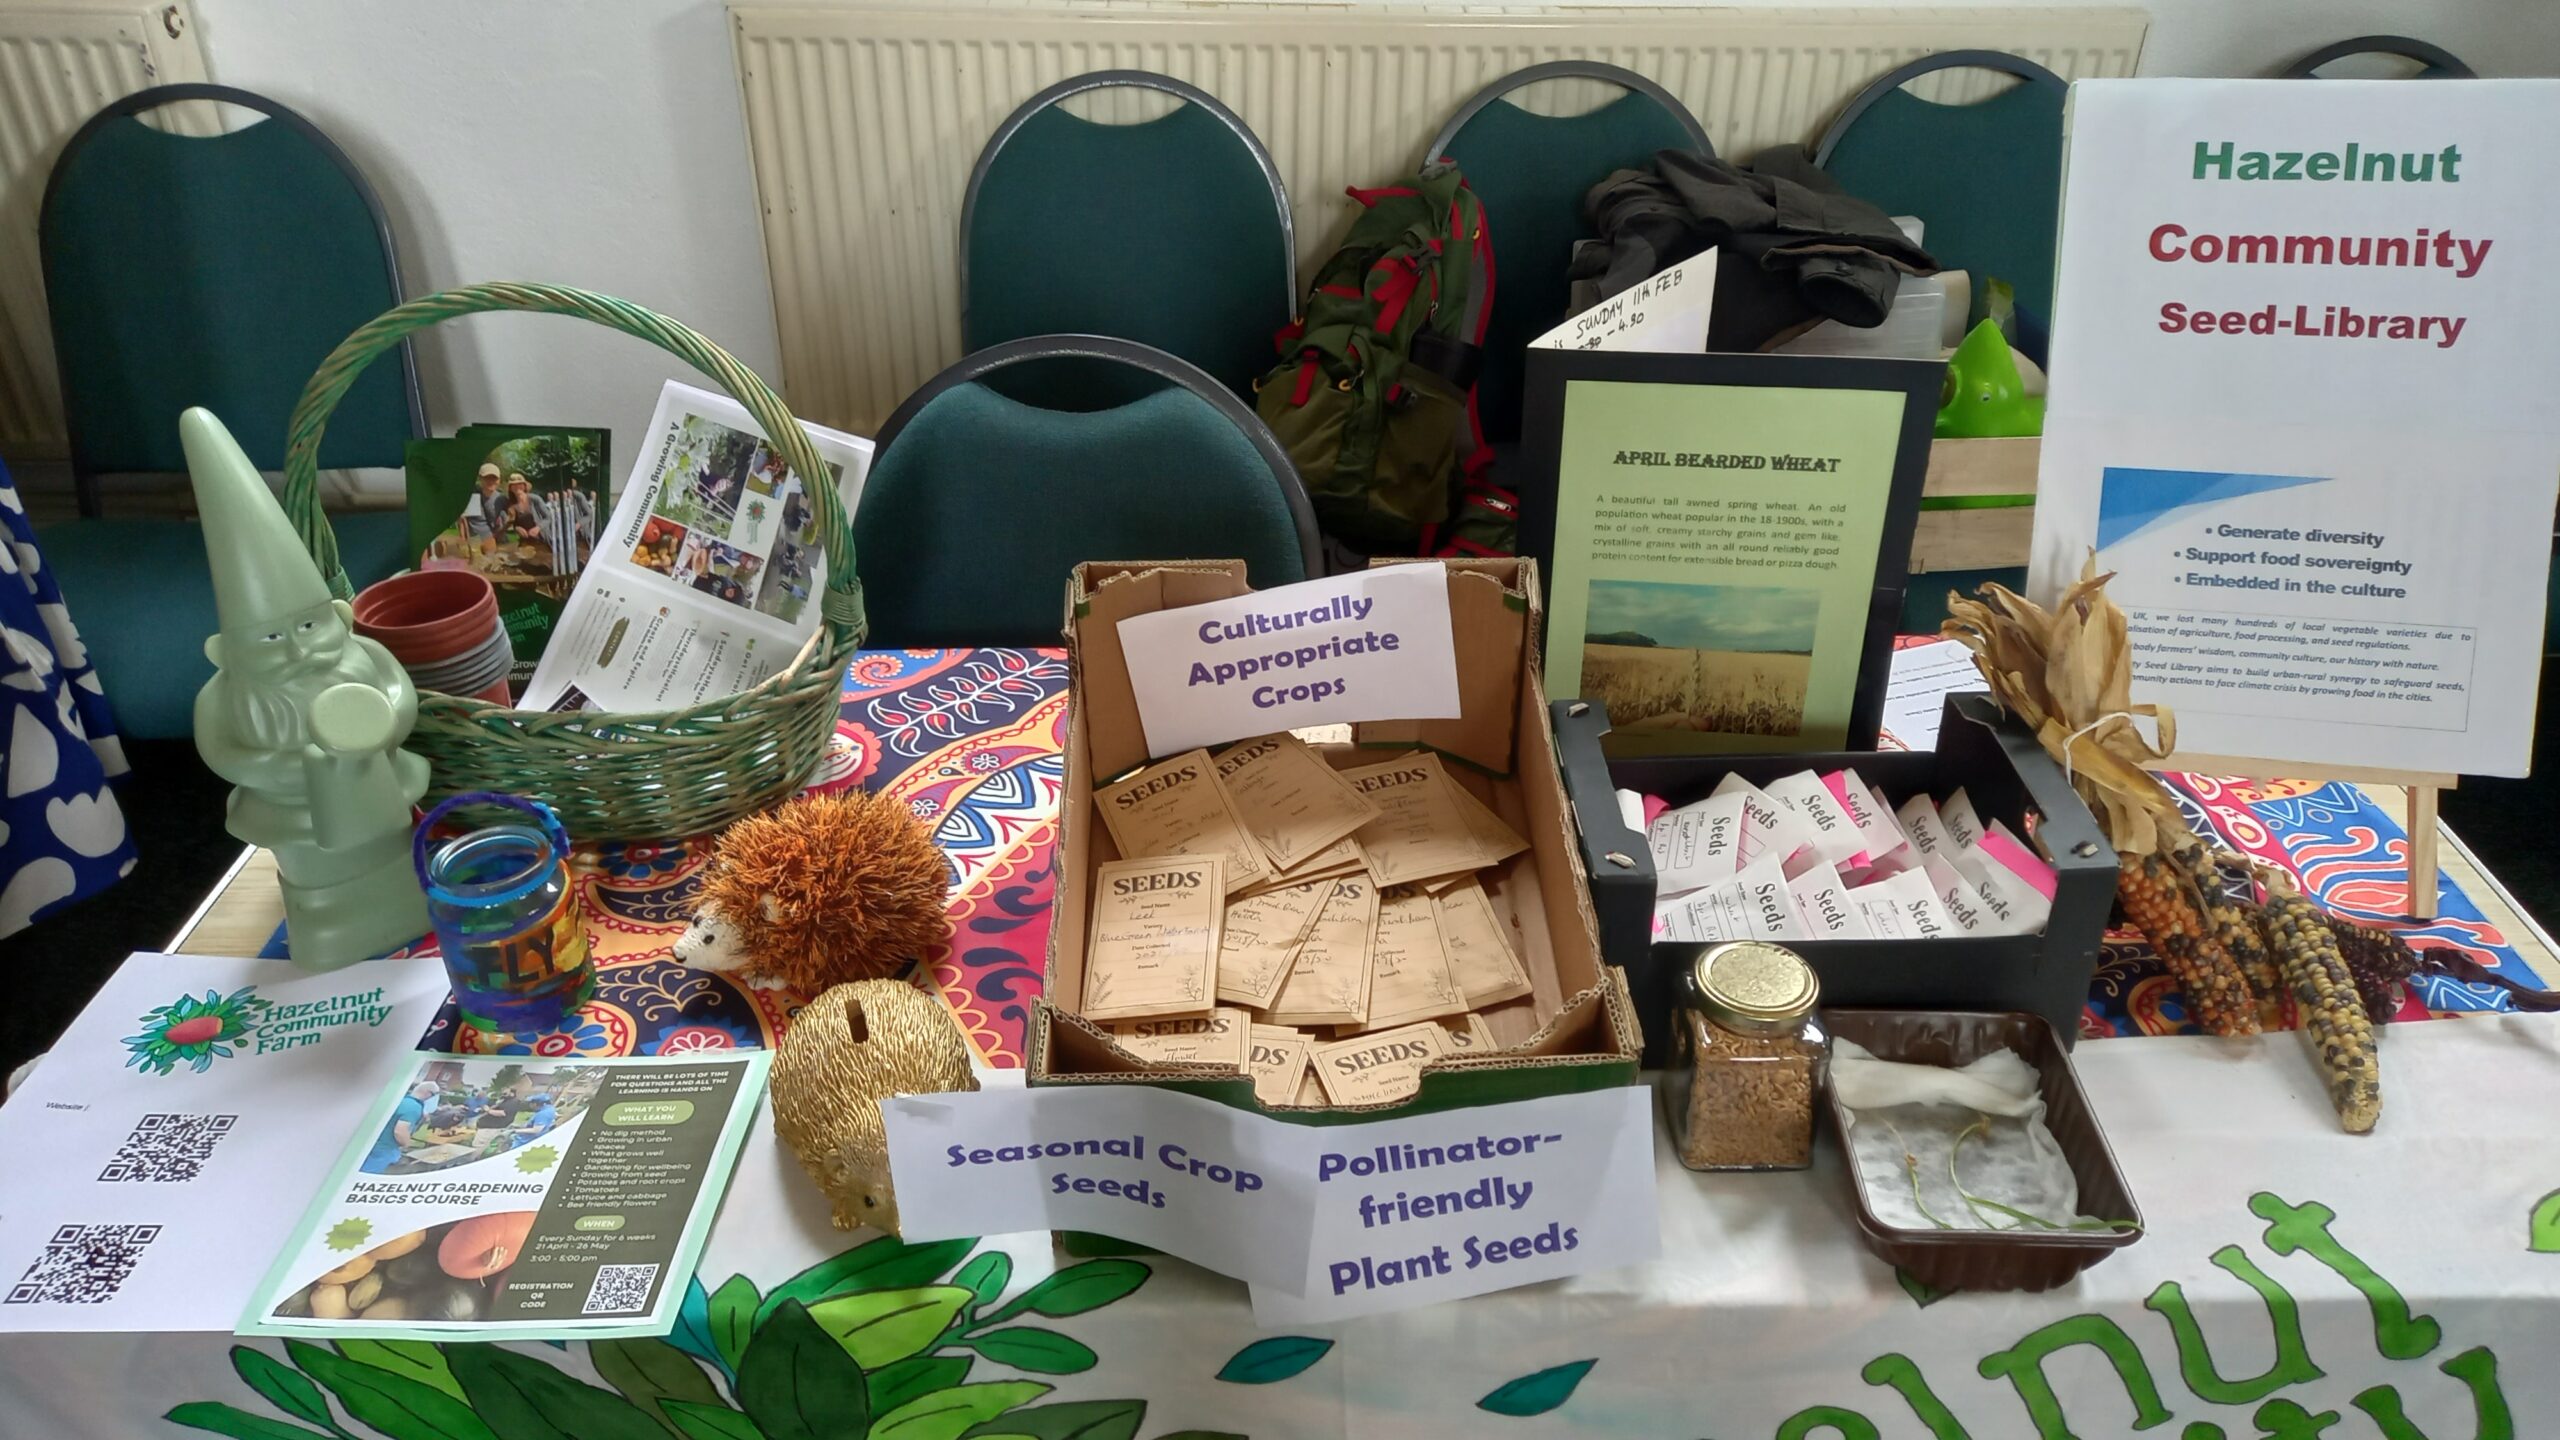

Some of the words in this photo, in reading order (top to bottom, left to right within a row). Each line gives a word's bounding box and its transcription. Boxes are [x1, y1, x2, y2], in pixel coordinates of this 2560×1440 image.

[2192, 142, 2462, 183] Hazelnut
[2149, 224, 2494, 278] Community
[1576, 299, 1624, 340] SUNDAY
[1655, 269, 1684, 297] FEB
[1618, 312, 1645, 332] 4.30
[2159, 302, 2467, 348] Seed-Library
[650, 433, 677, 484] Growing
[1613, 451, 1671, 466] APRIL
[1674, 453, 1767, 470] BEARDED
[1770, 454, 1842, 472] WHEAT
[622, 485, 658, 548] Community
[1595, 509, 1649, 519] population
[1652, 512, 1682, 521] wheat
[1685, 513, 1724, 522] popular
[1727, 515, 1737, 523] in
[1740, 515, 1756, 524] the
[1812, 518, 1834, 527] with
[1596, 495, 1604, 503] A
[1612, 496, 1656, 505] beautiful
[1663, 498, 1679, 506] tall
[1686, 499, 1720, 508] awned
[1728, 501, 1758, 511] spring
[1808, 503, 1822, 511] An
[1830, 504, 1847, 513] old
[1593, 538, 1642, 547] crystalline
[1646, 540, 1676, 549] grains
[1680, 541, 1701, 550] with
[1706, 543, 1719, 551] an
[1722, 543, 1735, 551] all
[1739, 544, 1769, 553] round
[1813, 547, 1840, 556] good
[2217, 524, 2301, 541] Generate
[2305, 529, 2384, 549] diversity
[2186, 548, 2256, 565] Support
[2261, 551, 2300, 567] food
[2305, 556, 2412, 576] sovereignty
[2187, 573, 2279, 591] Embedded
[2285, 578, 2301, 592] in
[2306, 580, 2336, 594] the
[2341, 582, 2407, 598] culture
[1199, 595, 1373, 644] Culturally
[2177, 614, 2194, 623] lost
[2202, 617, 2228, 626] many
[2235, 618, 2278, 629] hundreds
[2285, 621, 2296, 630] of
[2302, 622, 2325, 632] local
[2332, 625, 2379, 636] vegetable
[2386, 628, 2427, 639] varieties
[2435, 631, 2453, 641] due
[2461, 633, 2472, 641] to
[2167, 627, 2179, 637] of
[2179, 628, 2232, 640] agriculture,
[2234, 631, 2257, 641] food
[2257, 634, 2309, 645] processing,
[2311, 637, 2330, 645] and
[2332, 638, 2354, 647] seed
[2355, 640, 2411, 651] regulations.
[1188, 631, 1400, 687] Appropriate
[2145, 661, 2167, 670] Seed
[2170, 663, 2203, 673] Library
[2206, 665, 2229, 674] aims
[2233, 667, 2243, 675] to
[2247, 668, 2270, 678] build
[2272, 671, 2327, 682] urban-rural
[2330, 674, 2367, 685] synergy
[2370, 677, 2381, 685] to
[2384, 678, 2433, 690] safeguard
[2436, 682, 2465, 692] seeds,
[2198, 647, 2236, 657] wisdom,
[2239, 650, 2291, 661] community
[2292, 653, 2328, 664] culture,
[2329, 657, 2346, 665] our
[2348, 657, 2381, 669] history
[2382, 660, 2404, 669] with
[2406, 662, 2440, 671] nature.
[1252, 678, 1346, 709] Crops
[2169, 677, 2202, 686] actions
[2205, 679, 2215, 687] to
[2216, 679, 2236, 689] face
[2238, 681, 2271, 691] climate
[2273, 684, 2297, 693] crisis
[2298, 686, 2311, 696] by
[2312, 688, 2351, 699] growing
[2351, 690, 2375, 700] food
[2377, 691, 2386, 700] in
[2387, 692, 2403, 701] the
[2405, 694, 2433, 702] cities.
[1217, 736, 1280, 780] EEDS
[1116, 765, 1198, 810] SEEDS
[1745, 795, 1779, 830] Seeds
[1801, 794, 1836, 832] Seeds
[1846, 792, 1872, 829] Seeds
[1708, 816, 1731, 856] Seeds
[1910, 816, 1937, 854] Seeds
[1950, 812, 1974, 849] Seeds
[1113, 871, 1202, 896] SEEDS
[1976, 881, 2011, 922] Seeds
[1755, 883, 1786, 932] Seeds
[1815, 888, 1847, 931] Seeds
[1908, 899, 1942, 940] Seeds
[1942, 887, 1979, 931] Seeds
[256, 1005, 394, 1039] Community
[261, 987, 385, 1024] Hazelnut
[255, 1032, 321, 1056] Farm
[1135, 1018, 1231, 1039] SEEDS
[1335, 1040, 1430, 1076] SEEDS
[947, 1135, 1144, 1167] Seasonal
[1158, 1143, 1263, 1193] Crop
[1319, 1133, 1563, 1182] Pollinator-
[345, 1194, 409, 1204] BASICS
[411, 1194, 482, 1206] COURSE
[352, 1182, 441, 1193] HAZELNUT
[443, 1183, 545, 1194] GARDENING
[1051, 1172, 1166, 1208] Seeds
[1359, 1176, 1533, 1228] friendly
[539, 1235, 564, 1243] Every
[566, 1234, 601, 1243] Sunday
[602, 1234, 617, 1242] for
[583, 1220, 616, 1228] WHEN
[1329, 1245, 1452, 1296] Plant
[1463, 1222, 1579, 1270] Seeds
[531, 1292, 544, 1300] QR
